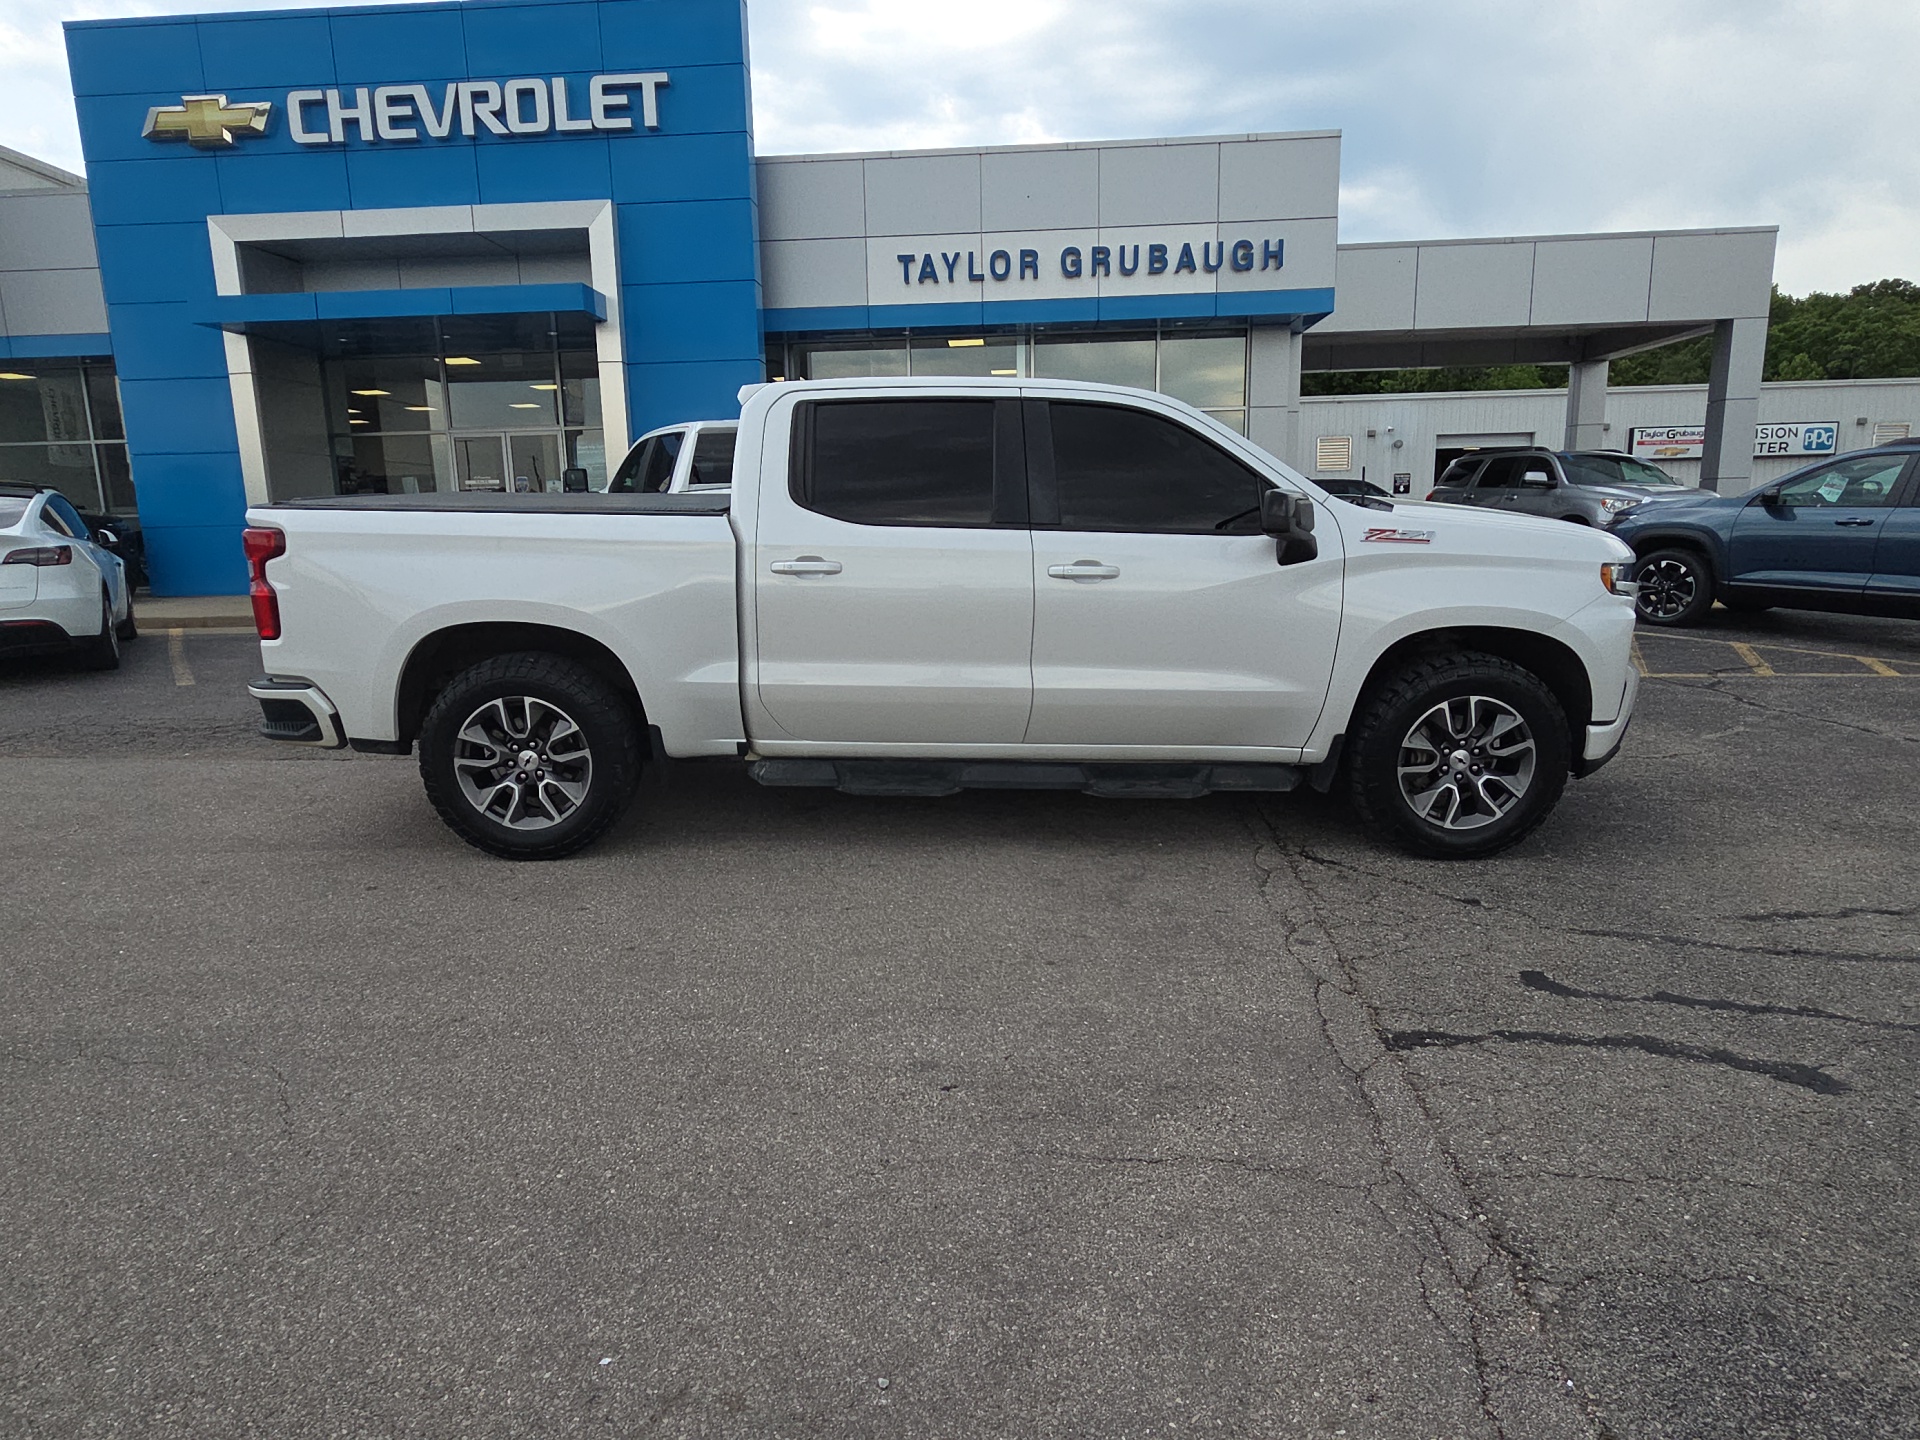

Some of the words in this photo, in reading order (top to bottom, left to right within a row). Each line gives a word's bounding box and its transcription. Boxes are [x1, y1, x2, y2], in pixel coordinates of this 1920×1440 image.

[287, 72, 669, 145] CHEVROLET
[897, 249, 1039, 284] TAYLOR
[1061, 238, 1284, 279] GRUBAUGH
[1638, 429, 1665, 439] Taylor
[1804, 428, 1833, 449] PPG
[1753, 442, 1789, 453] TER
[1361, 527, 1435, 544] Z71
